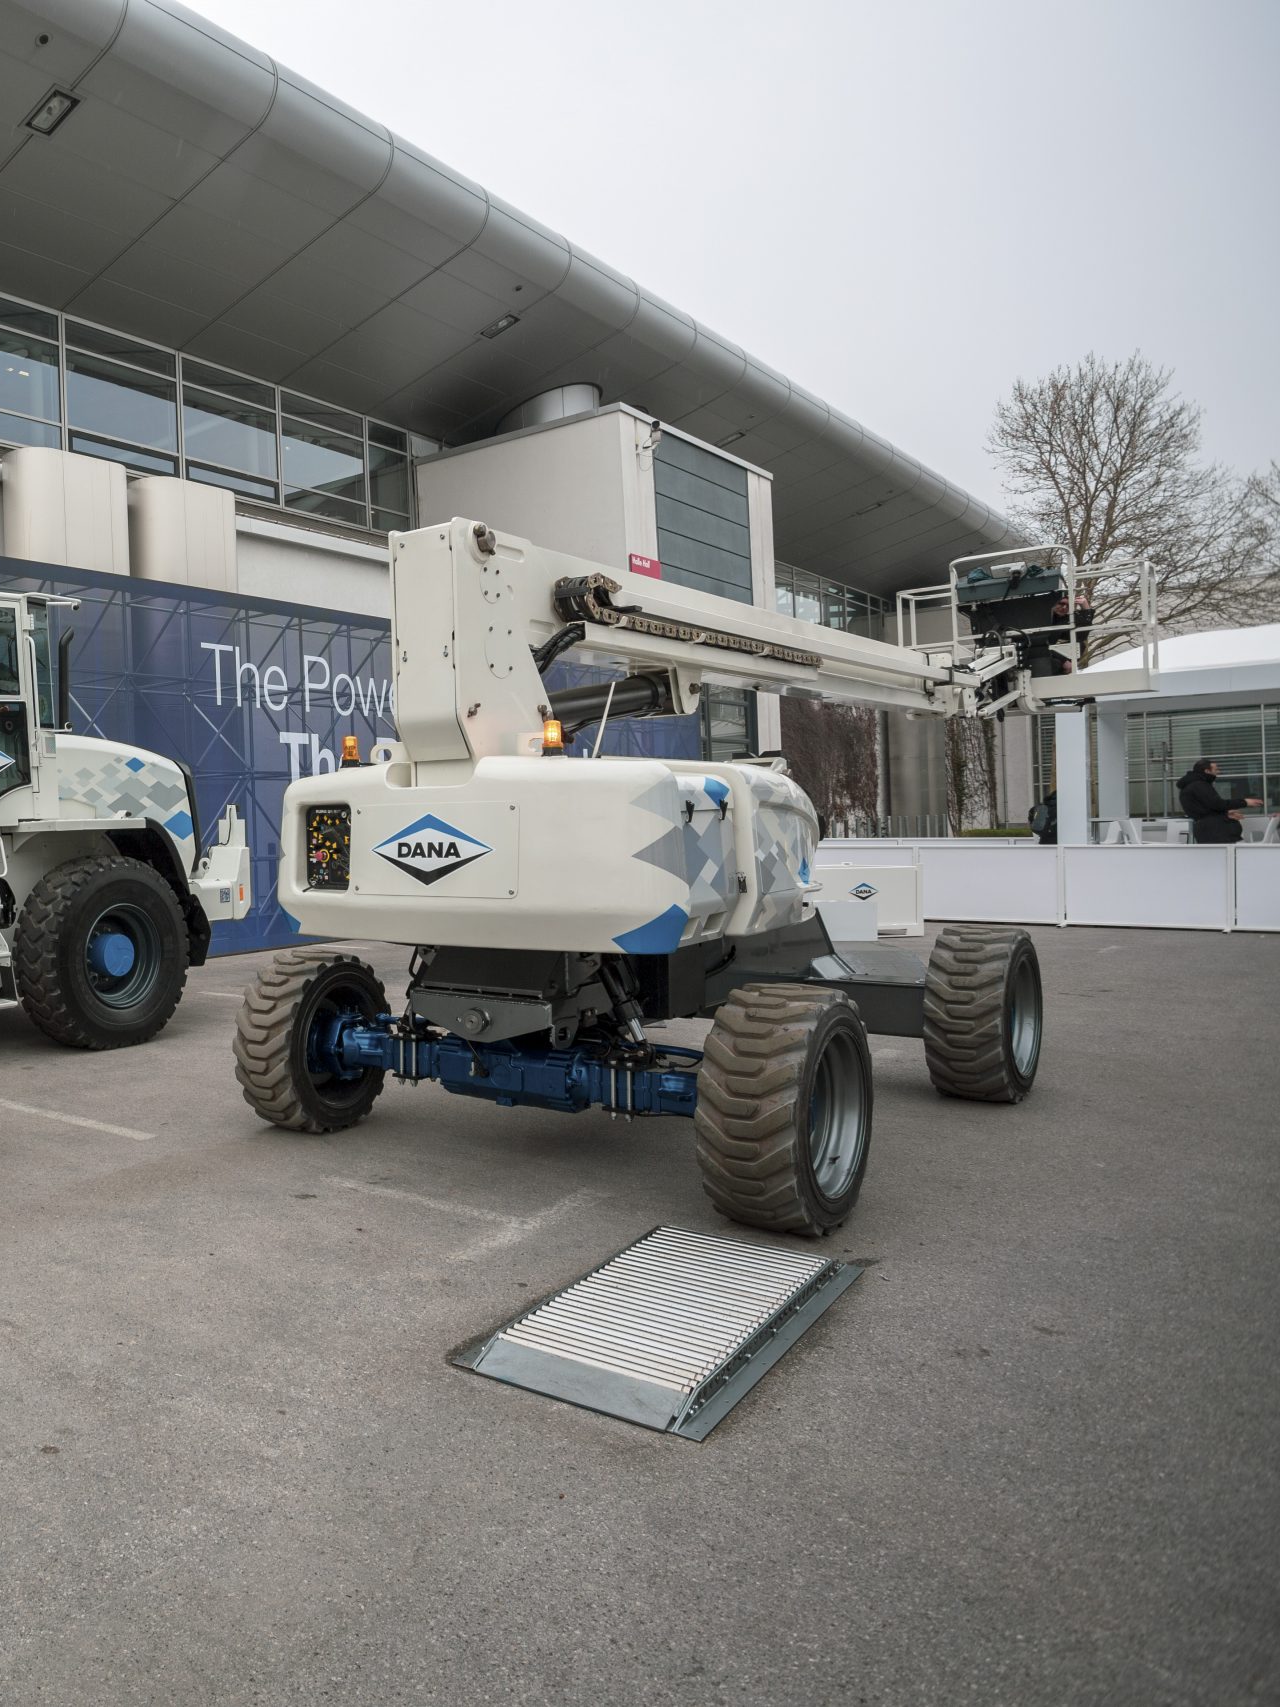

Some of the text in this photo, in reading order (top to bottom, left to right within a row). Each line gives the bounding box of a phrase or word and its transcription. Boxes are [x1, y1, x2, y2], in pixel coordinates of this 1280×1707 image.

[201, 642, 401, 718] The Pow
[280, 732, 343, 782] Th
[398, 842, 461, 858] DANA
